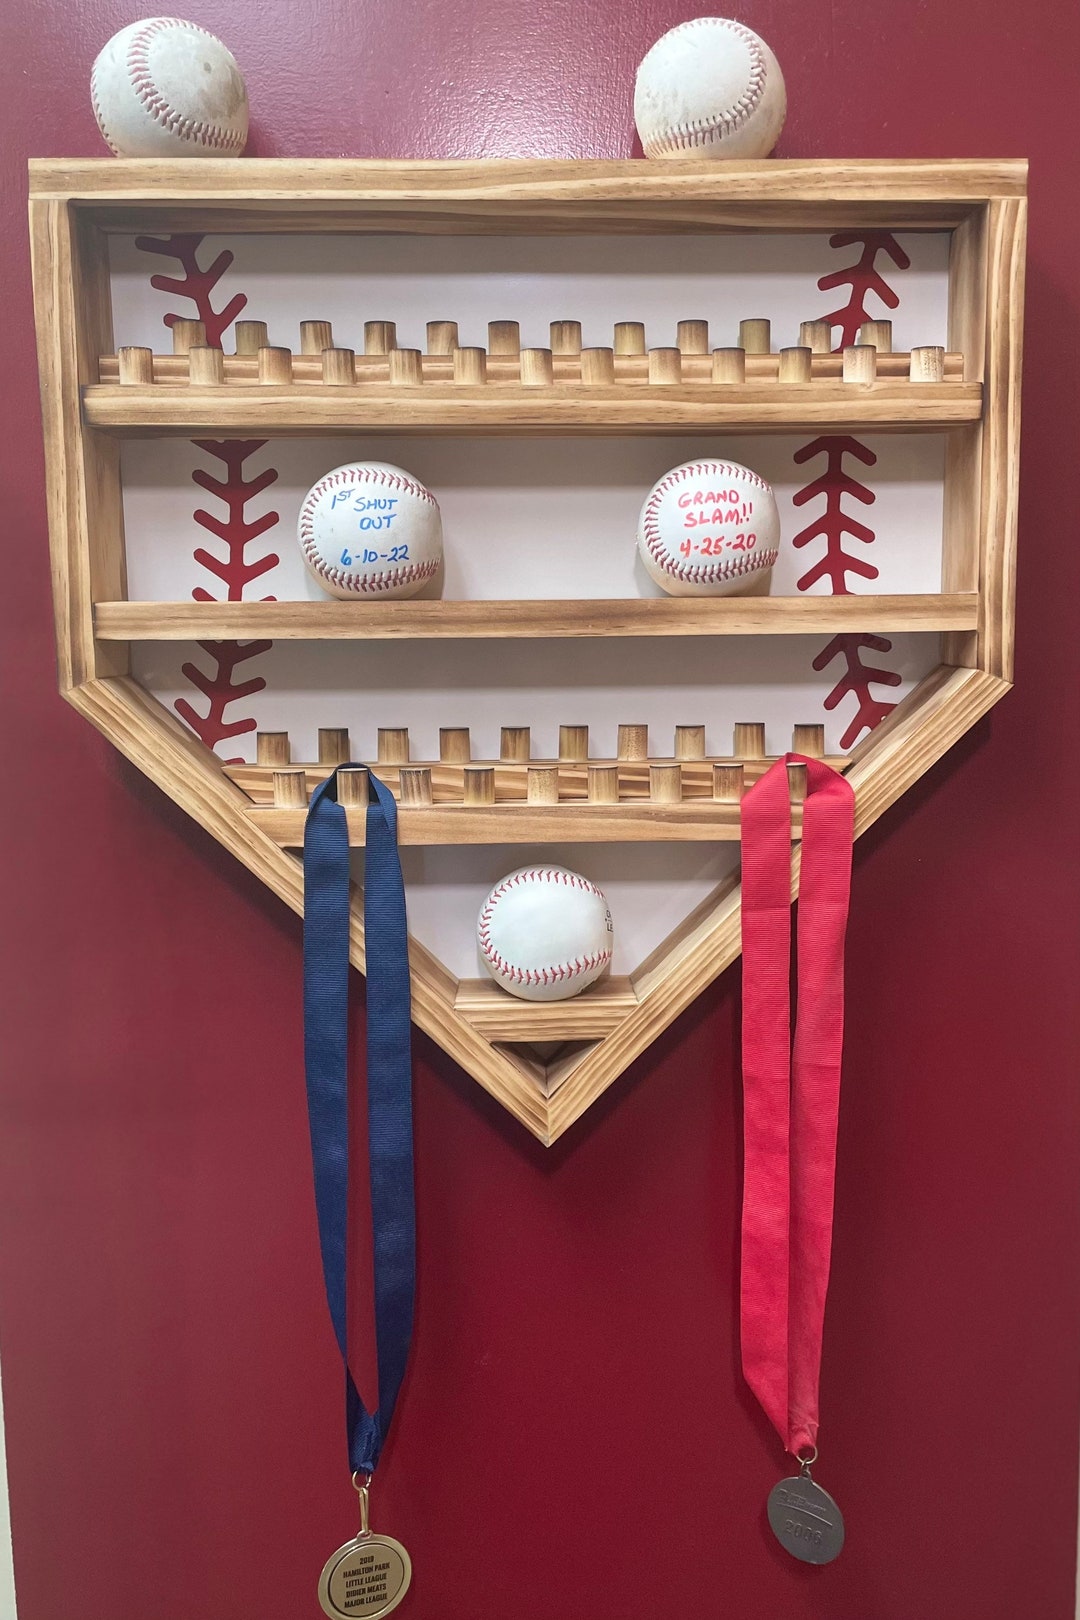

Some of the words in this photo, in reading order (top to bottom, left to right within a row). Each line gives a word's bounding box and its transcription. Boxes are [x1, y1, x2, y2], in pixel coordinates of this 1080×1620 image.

[331, 488, 356, 510] 1ST
[353, 496, 398, 512] SHUT
[678, 489, 740, 508] GRAND
[359, 513, 397, 530] OUT
[684, 502, 753, 527] SLAM!!
[679, 533, 757, 558] 4-25-20
[340, 544, 409, 566] 6-10-22
[343, 1566, 373, 1578] HAMILTON
[374, 1562, 390, 1572] PARK
[345, 1578, 364, 1588] LITTLE
[364, 1573, 387, 1584] LEAGUE
[366, 1583, 387, 1594] MEATS
[344, 1598, 365, 1608] MAJOR
[365, 1593, 388, 1604] LEAGUE
